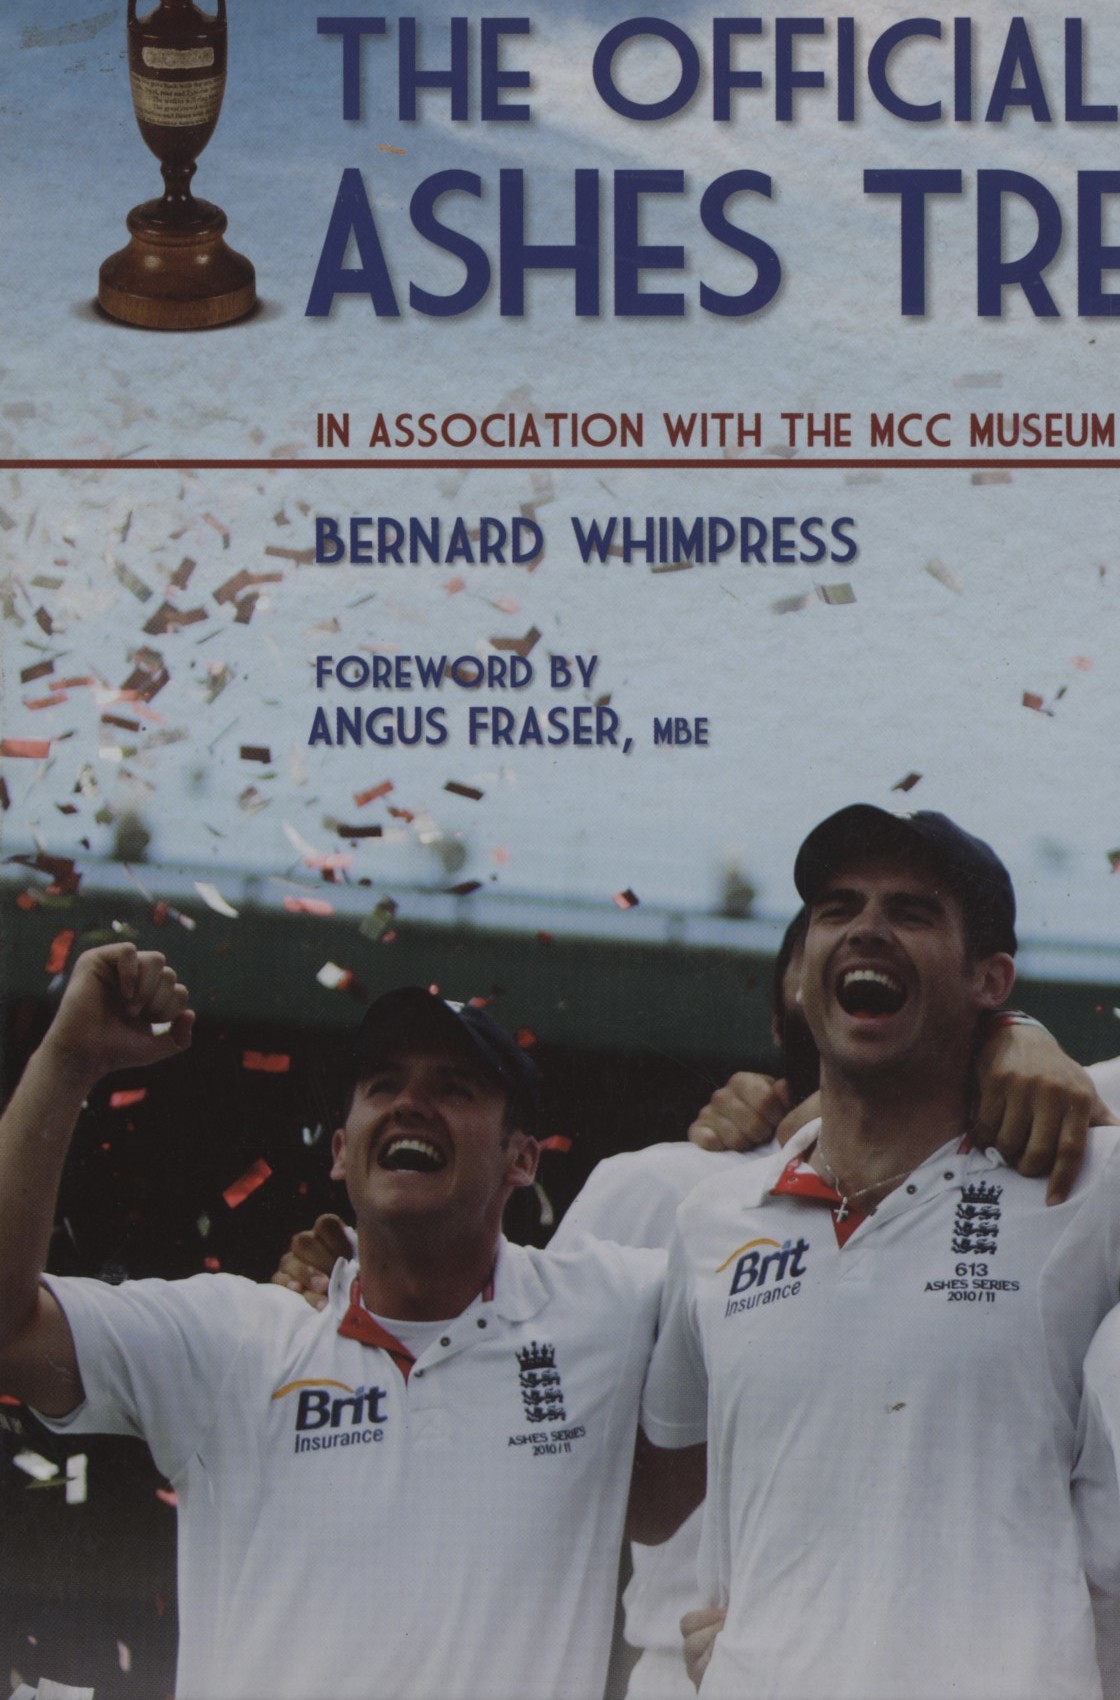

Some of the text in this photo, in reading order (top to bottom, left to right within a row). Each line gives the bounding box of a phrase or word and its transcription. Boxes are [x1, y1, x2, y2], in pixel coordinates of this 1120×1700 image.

[316, 17, 531, 121] THE
[591, 17, 1118, 122] OFFICIAL
[303, 168, 782, 318] ASHES
[316, 412, 350, 448] IN
[368, 412, 644, 448] ASSOCIATION
[664, 412, 762, 448] WITH
[781, 412, 852, 448] THE
[870, 412, 952, 448] MCC
[969, 412, 1116, 448] MUSEUM
[315, 516, 859, 564] BERNARD WHIMPRESS
[315, 655, 599, 689] FOREWORD BY
[307, 706, 710, 755] ANGUS FRASER, MBE
[729, 1237, 810, 1296] Brit
[924, 1279, 1020, 1292] ASHES SERIES
[954, 1262, 988, 1277] 613
[724, 1280, 802, 1319] Insurance
[295, 1385, 388, 1432] Brit
[294, 1427, 384, 1454] Insurance
[507, 1425, 586, 1447] ASHES SERIES
